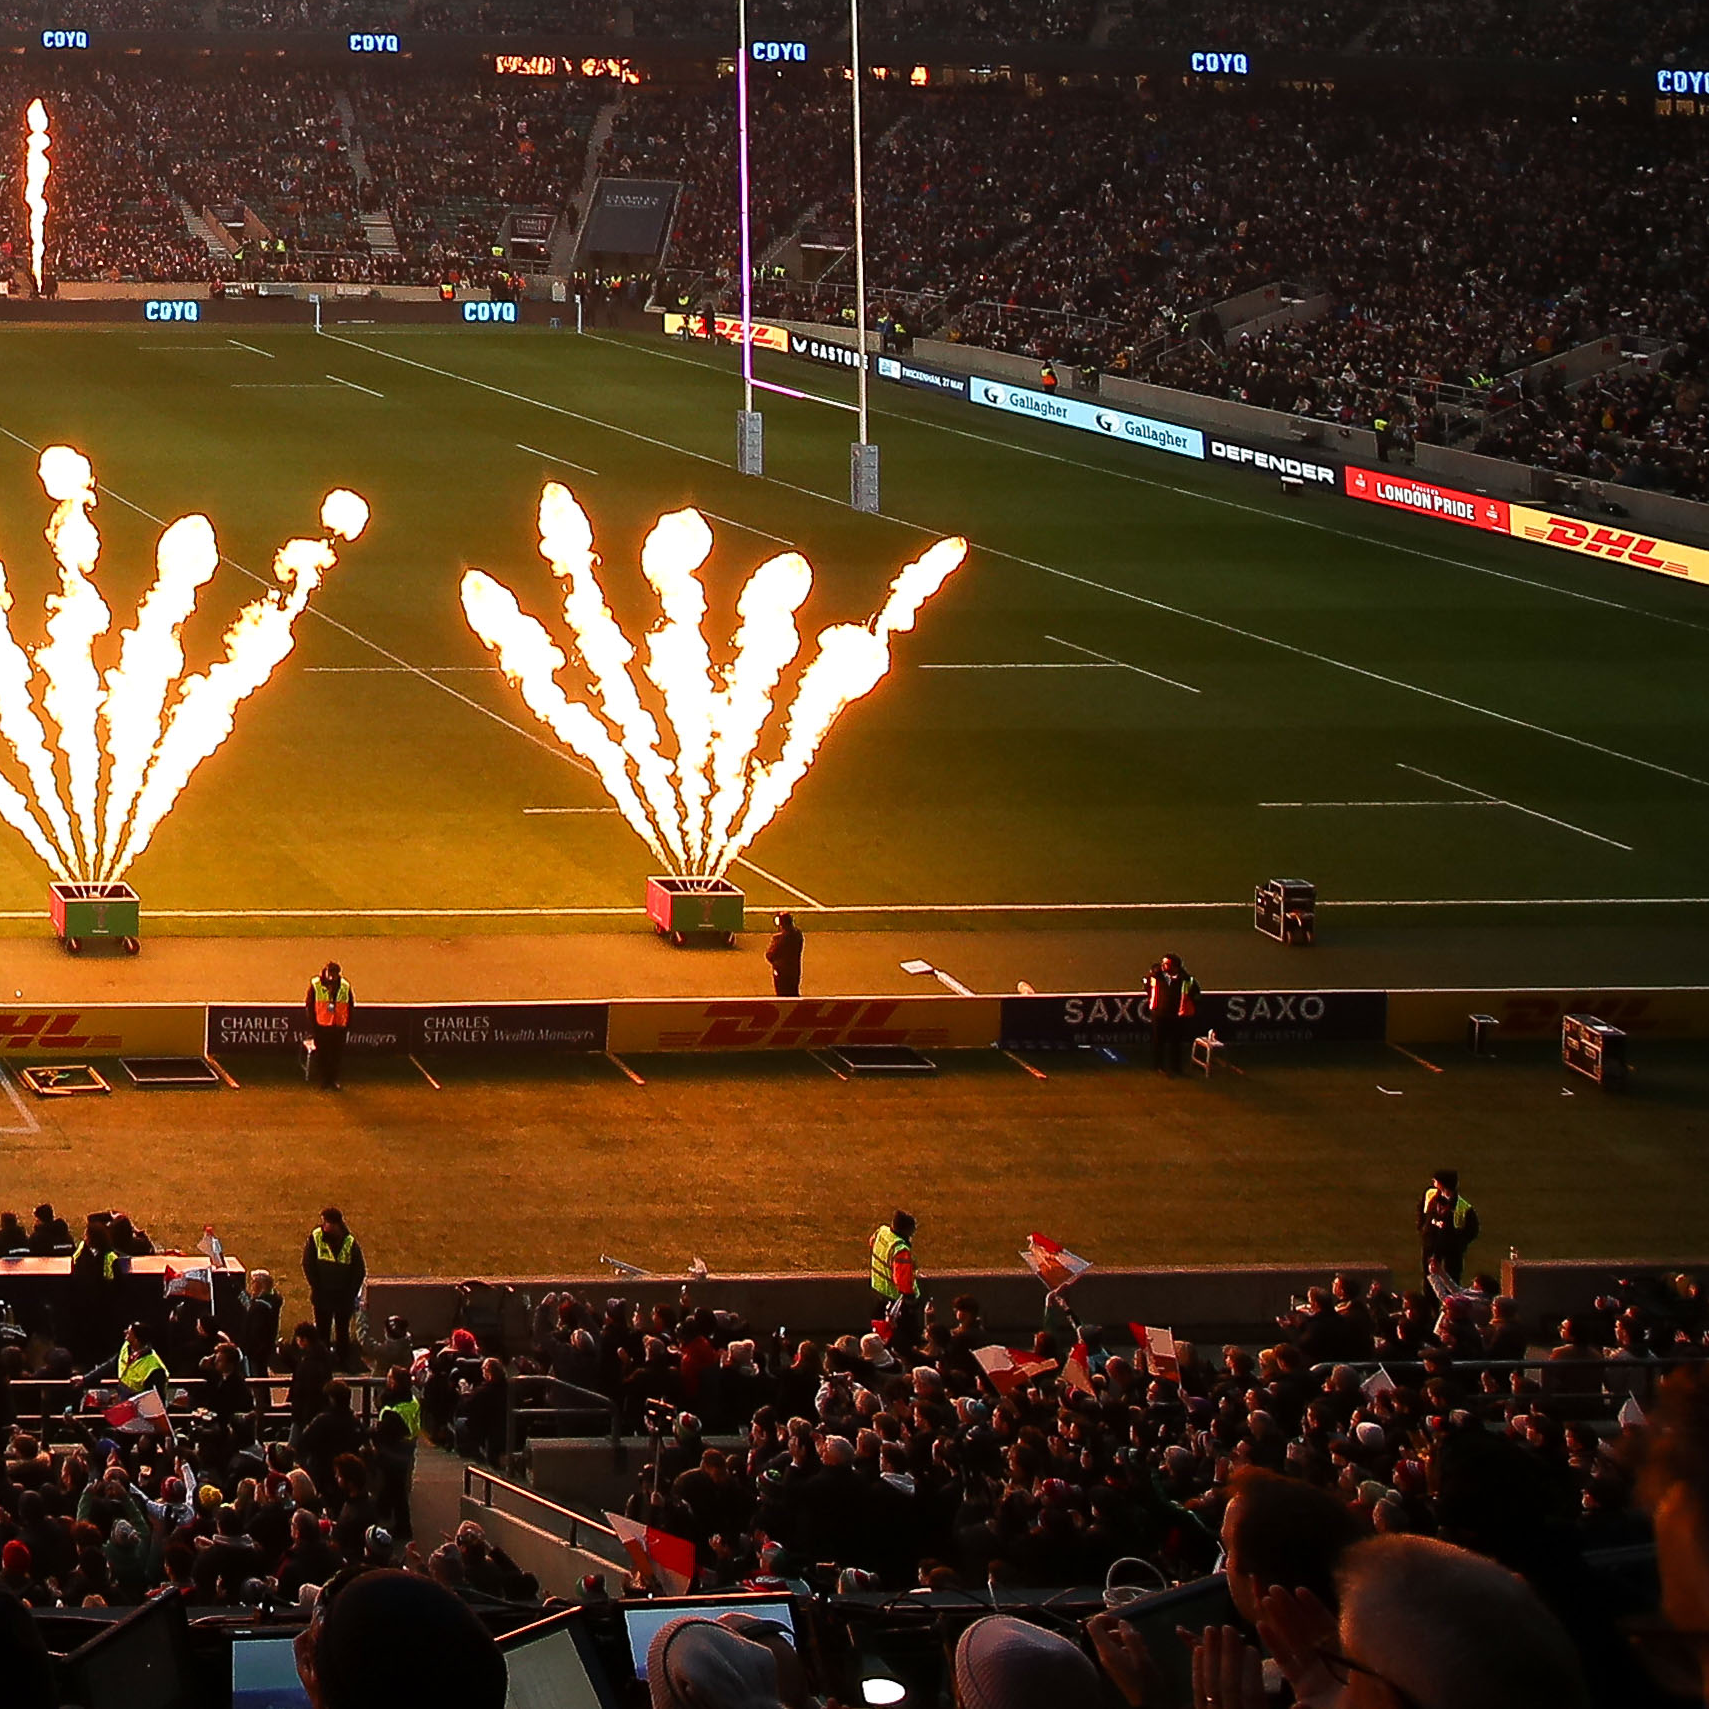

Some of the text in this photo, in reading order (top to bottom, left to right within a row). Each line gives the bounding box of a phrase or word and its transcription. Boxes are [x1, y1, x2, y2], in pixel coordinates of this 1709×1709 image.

[43, 32, 86, 48] COYQ
[350, 35, 397, 51] COYQ
[753, 43, 805, 61] COYQ
[1192, 53, 1247, 74] COYQ
[147, 301, 197, 321] COYQ
[465, 302, 515, 321] COYQ
[1009, 393, 1068, 419] Gallagher
[1125, 420, 1188, 449] Gallagher
[1211, 441, 1335, 485] DEFENDER
[1376, 482, 1475, 521] LONDON PRIDE
[1546, 517, 1665, 570] DHL
[1226, 995, 1326, 1022] SAXO
[221, 1017, 289, 1030] CHARLES
[424, 1016, 490, 1029] CHARLES
[696, 1002, 909, 1046] DHL
[221, 1031, 288, 1044] STANLEY
[346, 1031, 397, 1045] anagers
[424, 1028, 595, 1044] STANLEY Wealth Managers
